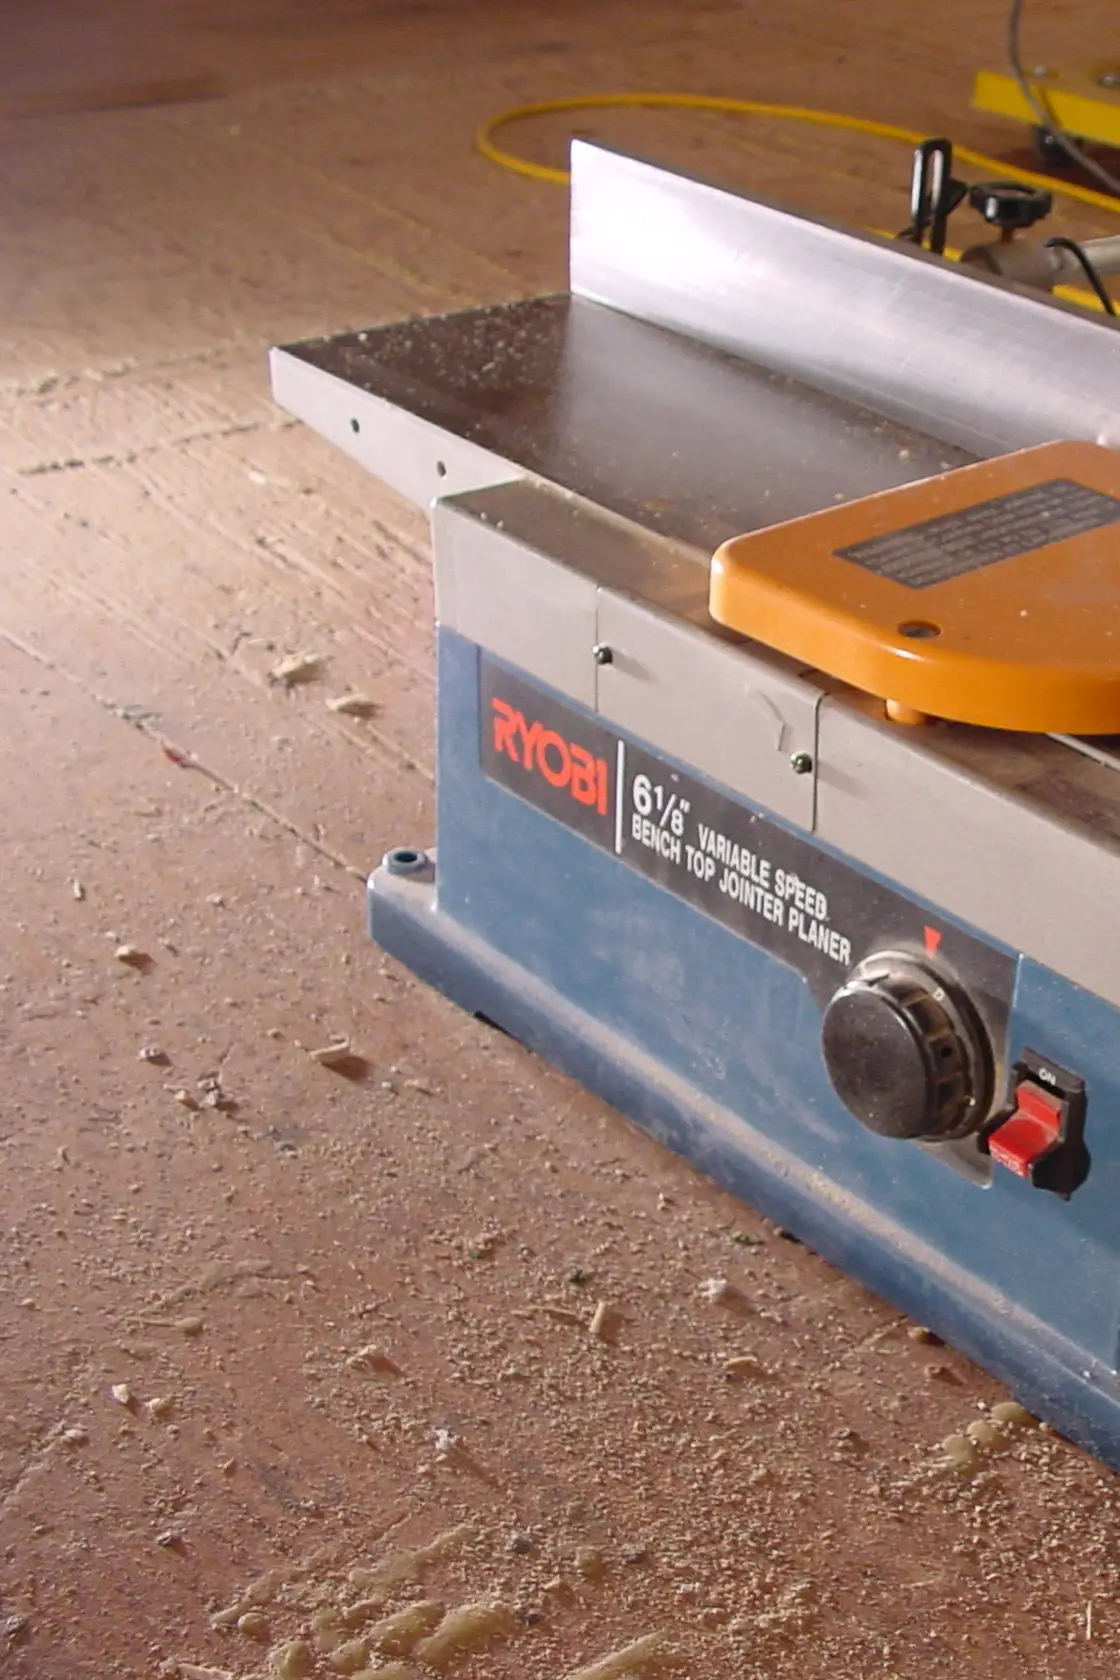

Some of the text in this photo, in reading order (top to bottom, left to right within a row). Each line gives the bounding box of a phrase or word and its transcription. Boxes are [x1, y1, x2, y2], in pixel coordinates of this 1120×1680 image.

[491, 697, 608, 816] RYOBI
[632, 813, 851, 966] BENCH TOP JOINTER PLANER
[698, 823, 771, 888] VARIABLE
[775, 868, 828, 921] SPEED
[1039, 1068, 1057, 1086] ON
